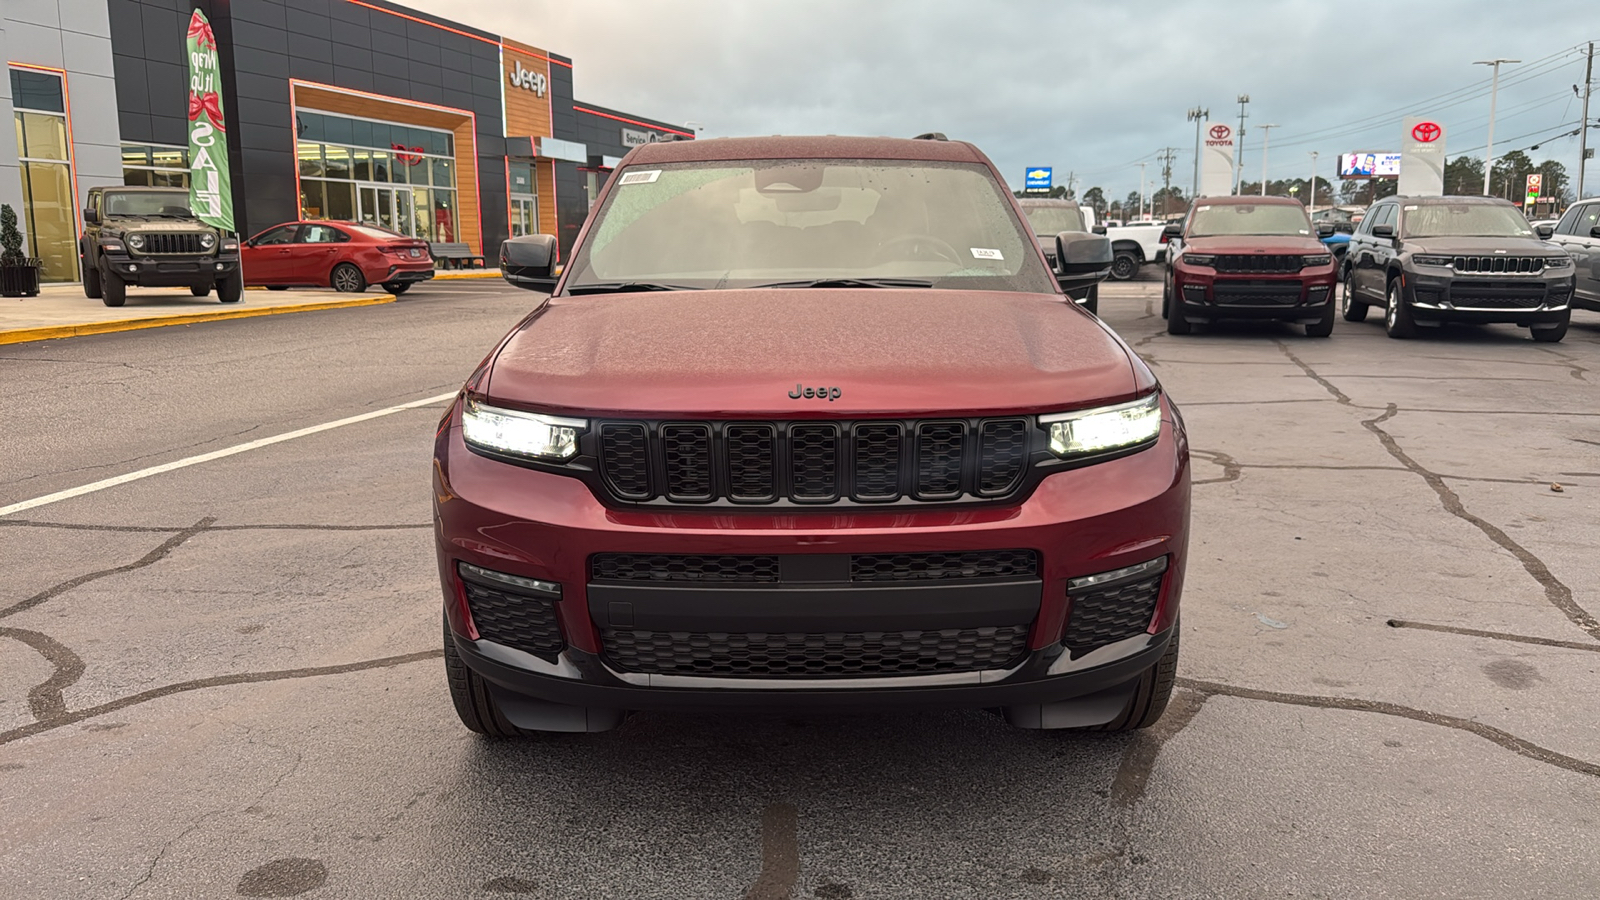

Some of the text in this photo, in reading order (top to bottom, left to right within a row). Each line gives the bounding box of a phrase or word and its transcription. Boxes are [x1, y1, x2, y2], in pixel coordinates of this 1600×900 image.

[510, 60, 546, 97] Jeep
[626, 132, 646, 145] Service
[788, 384, 842, 402] Jeep
